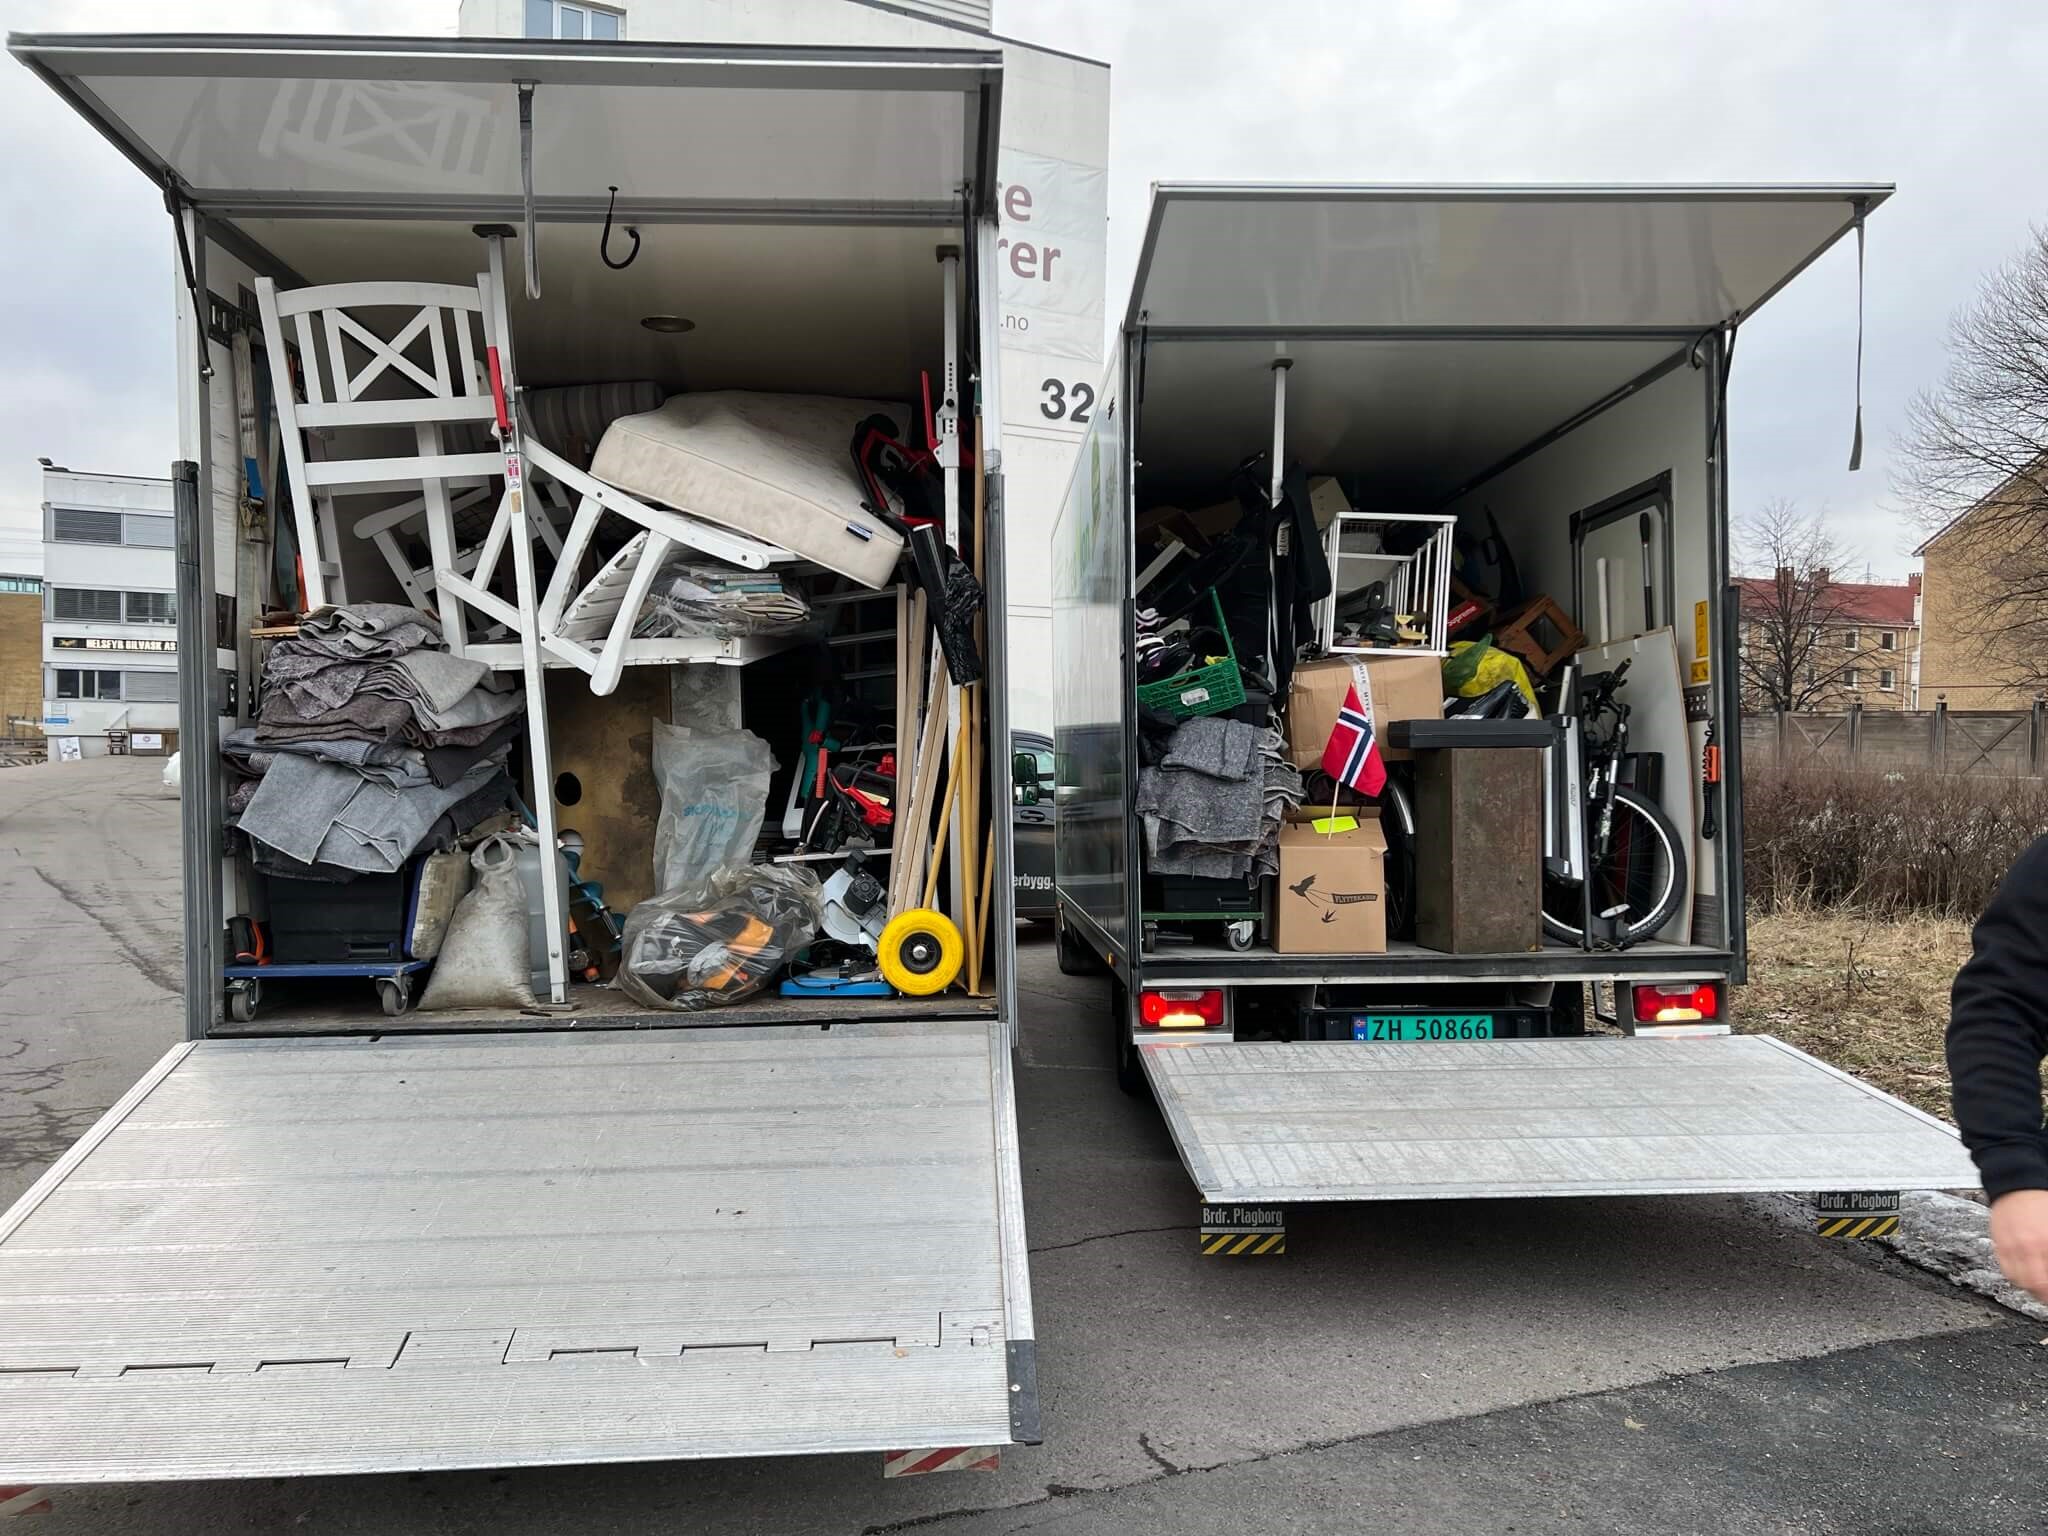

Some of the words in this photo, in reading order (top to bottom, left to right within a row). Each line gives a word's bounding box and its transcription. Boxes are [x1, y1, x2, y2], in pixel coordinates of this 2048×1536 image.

[998, 182, 1033, 222] e
[1000, 314, 1029, 331] .no
[1040, 377, 1095, 424] 32
[164, 642, 177, 652] AS
[1372, 1019, 1402, 1041] ZH
[1415, 1019, 1488, 1041] 50866
[1820, 1192, 1849, 1209] Brdr.
[1851, 1192, 1898, 1211] Plagborg
[1202, 1207, 1230, 1224] Brdr.
[1233, 1207, 1283, 1227] Plagborg
